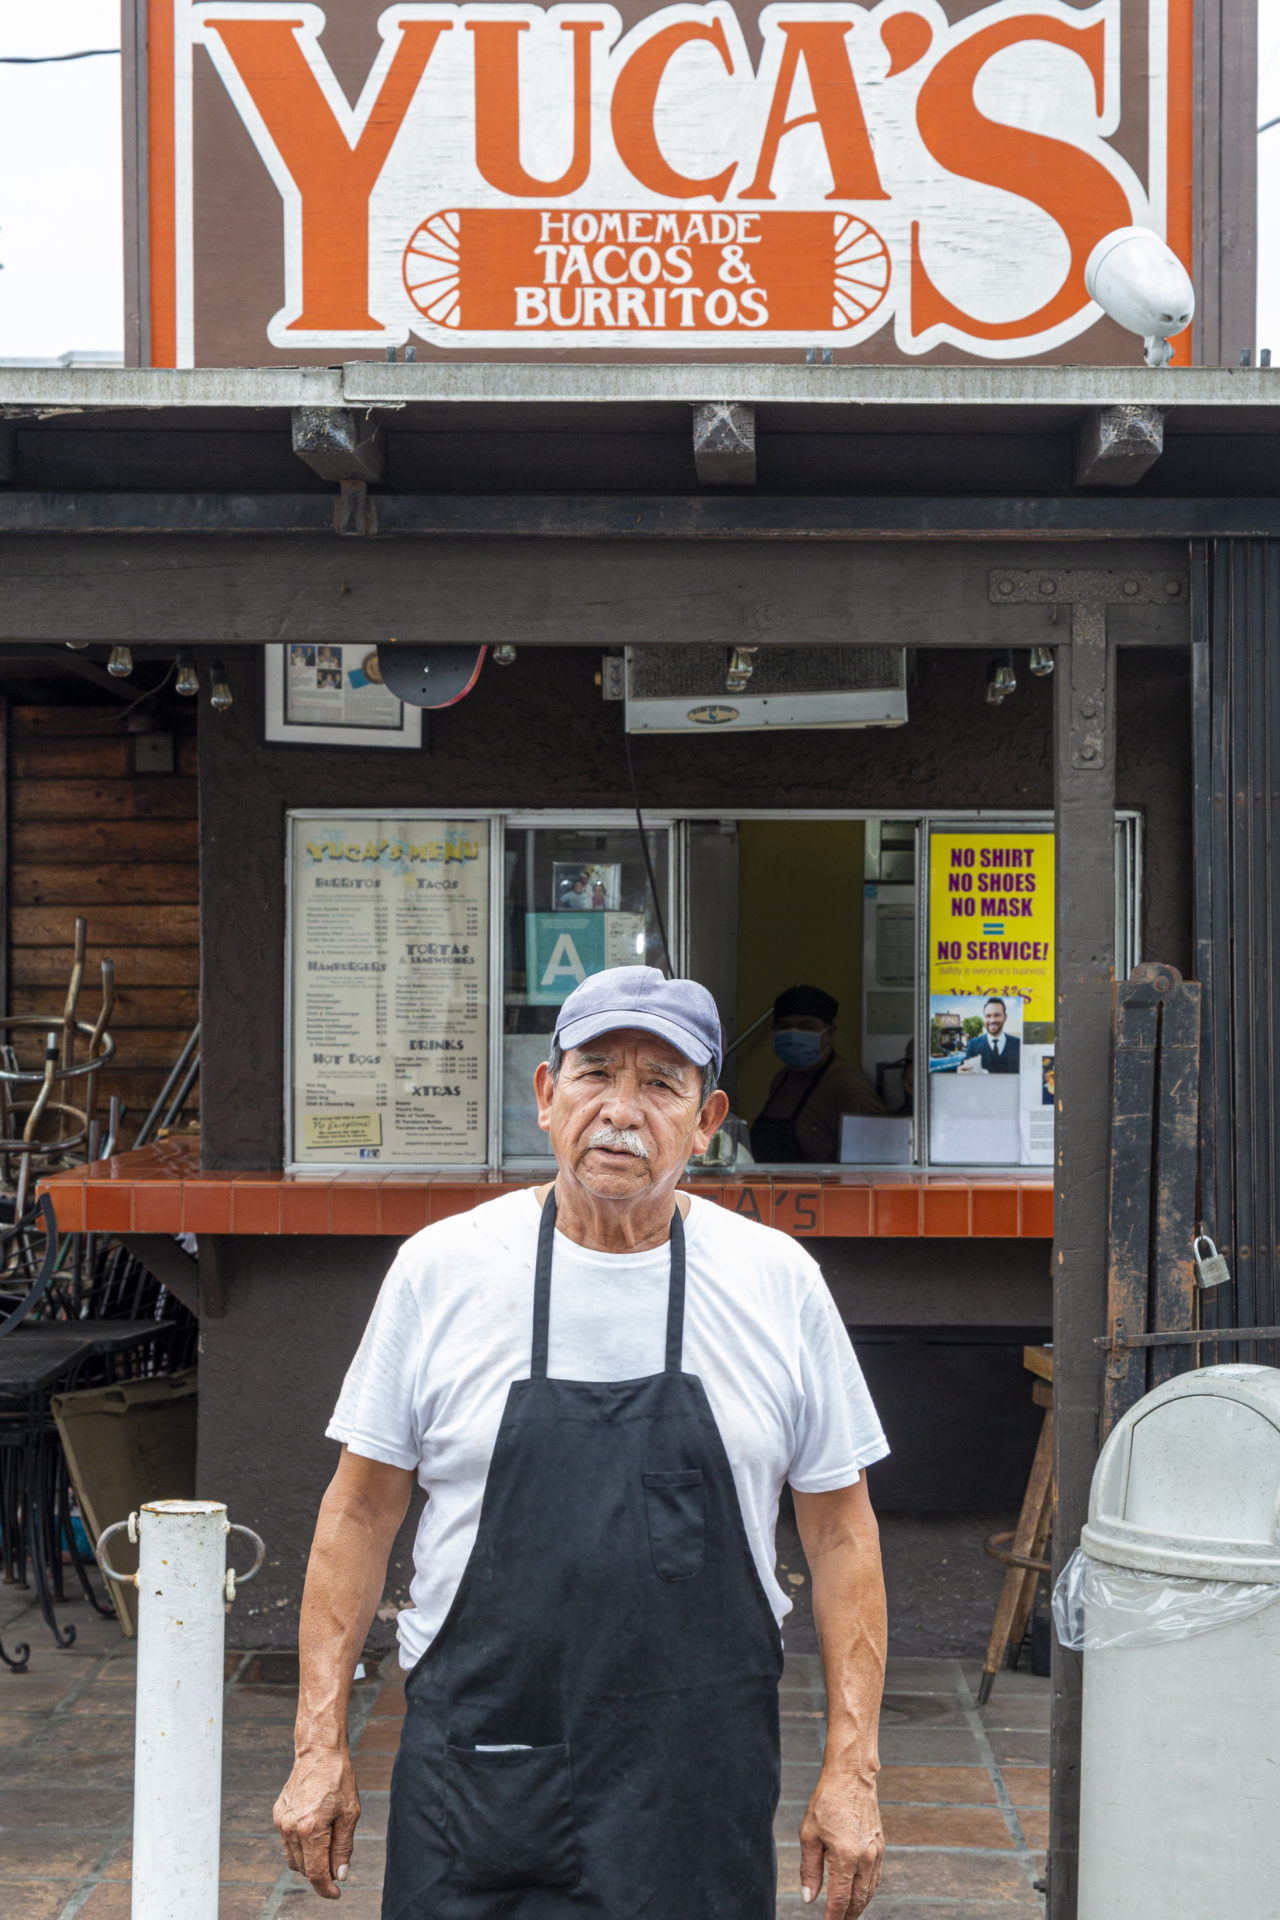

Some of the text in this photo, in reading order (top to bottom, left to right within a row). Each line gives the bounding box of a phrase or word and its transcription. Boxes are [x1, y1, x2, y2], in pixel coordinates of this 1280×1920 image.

[203, 11, 1137, 338] YUCA'S
[540, 212, 762, 244] HOMEMADE
[534, 244, 756, 284] TACOS &
[514, 287, 769, 327] BURRITOS
[409, 838, 479, 864] MENU
[951, 848, 1034, 868] NO SHIRT
[416, 878, 459, 890] TACOS
[948, 873, 1036, 893] NO SHOES
[951, 898, 1033, 917] NO MASK
[405, 943, 470, 956] TORTAS
[541, 933, 588, 986] A
[937, 941, 1049, 961] NO SERVICE!
[307, 961, 387, 972] HAMBURGERS
[409, 1039, 464, 1051] DRINKS
[313, 1053, 382, 1066] HOT DOGS
[412, 1085, 461, 1097] XTRAS
[702, 1187, 818, 1230] A'S
